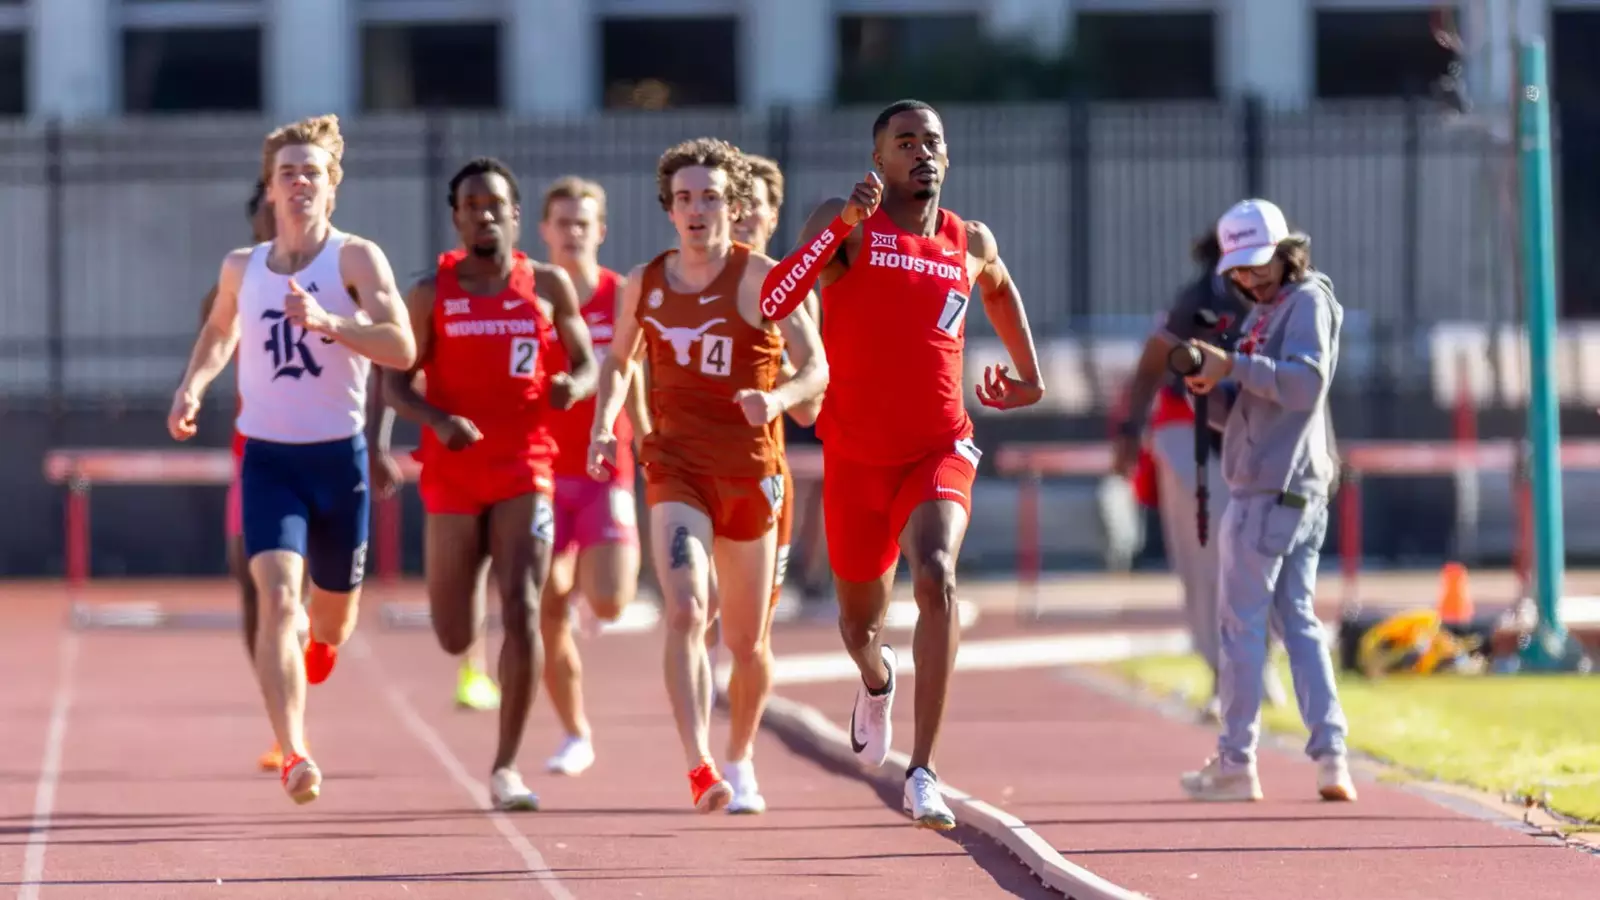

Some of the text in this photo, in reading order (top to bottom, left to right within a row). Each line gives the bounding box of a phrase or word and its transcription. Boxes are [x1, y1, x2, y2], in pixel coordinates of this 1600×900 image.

[761, 228, 835, 317] COUGARS
[870, 251, 961, 280] HOUSTON
[945, 292, 967, 330] 7
[444, 319, 535, 337] HOUSTON
[515, 342, 533, 373] 2
[706, 339, 725, 373] 4
